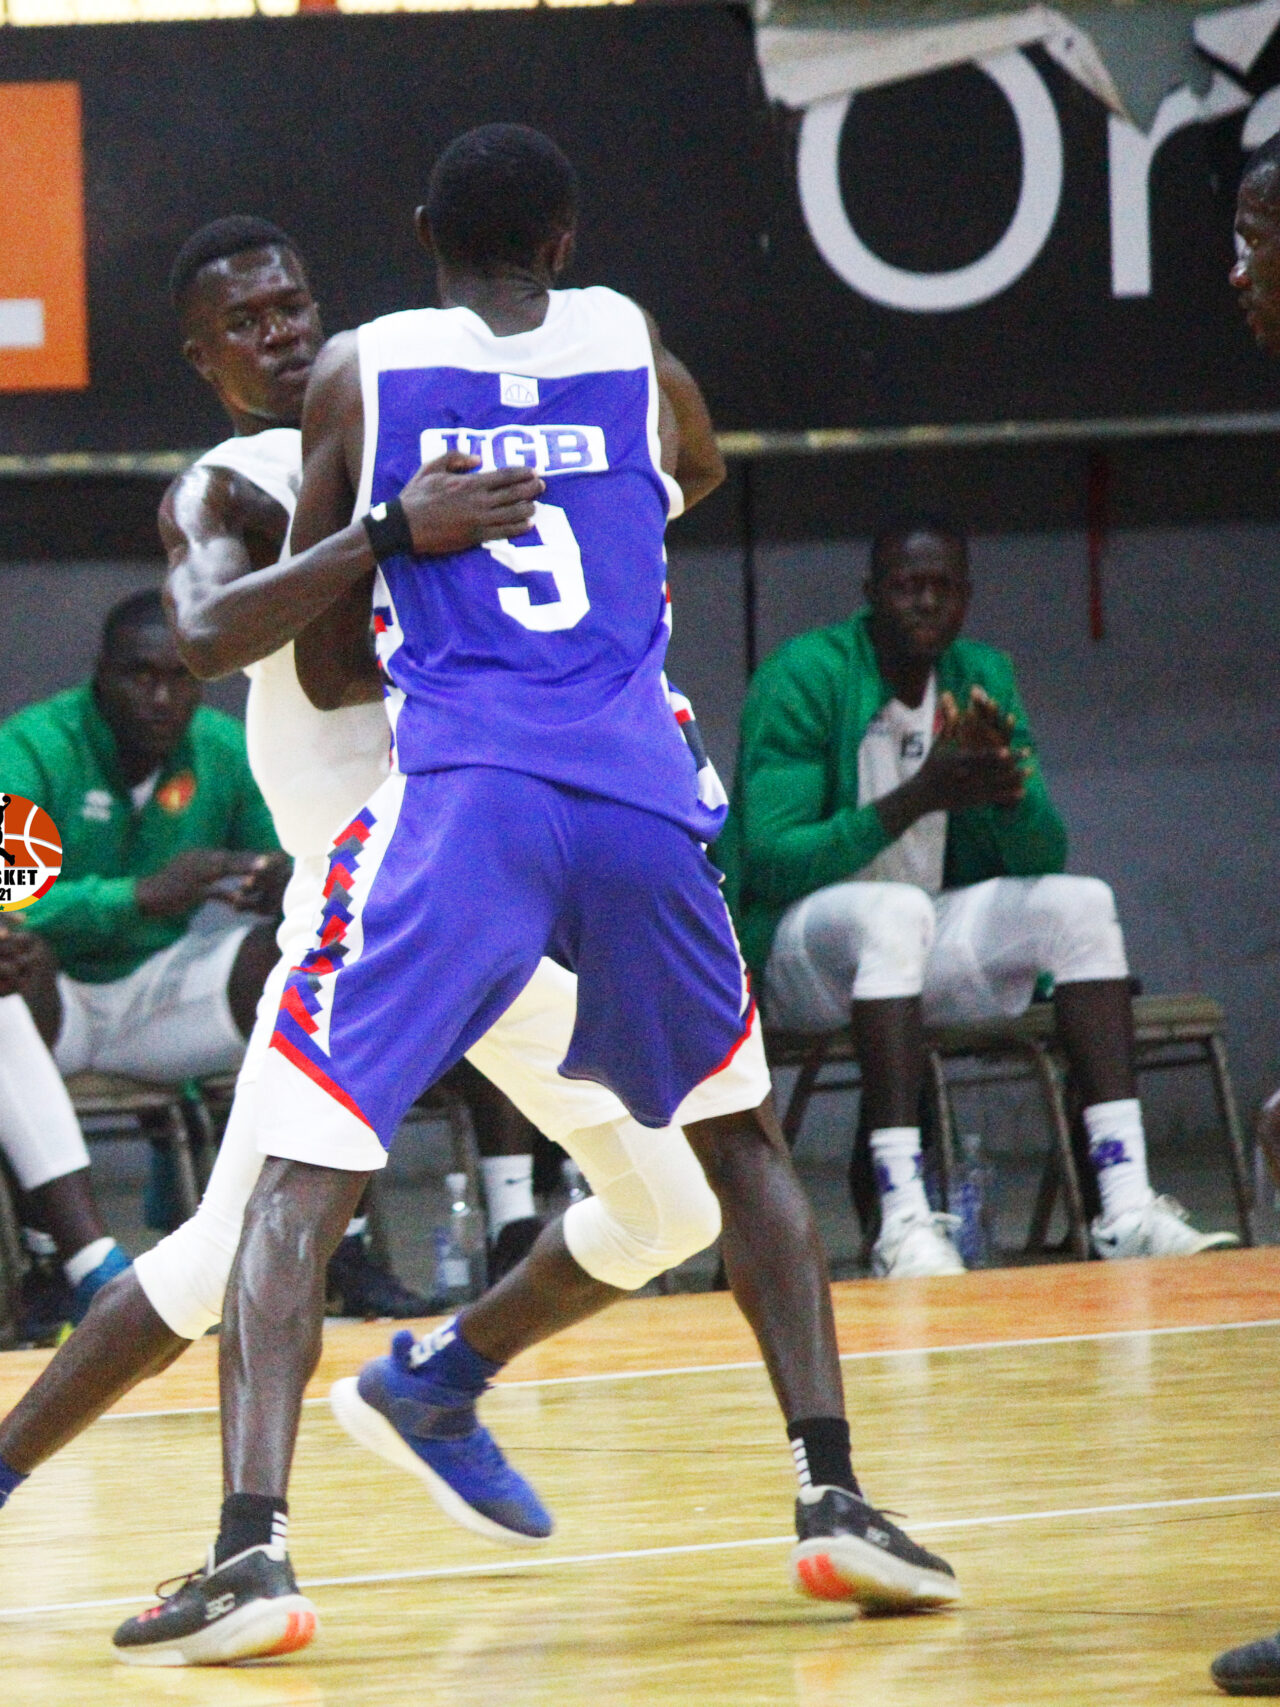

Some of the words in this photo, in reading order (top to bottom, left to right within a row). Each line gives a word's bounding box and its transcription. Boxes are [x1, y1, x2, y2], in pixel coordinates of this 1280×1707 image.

[797, 46, 1280, 313] Or
[440, 428, 594, 473] UGB
[482, 500, 591, 633] 9
